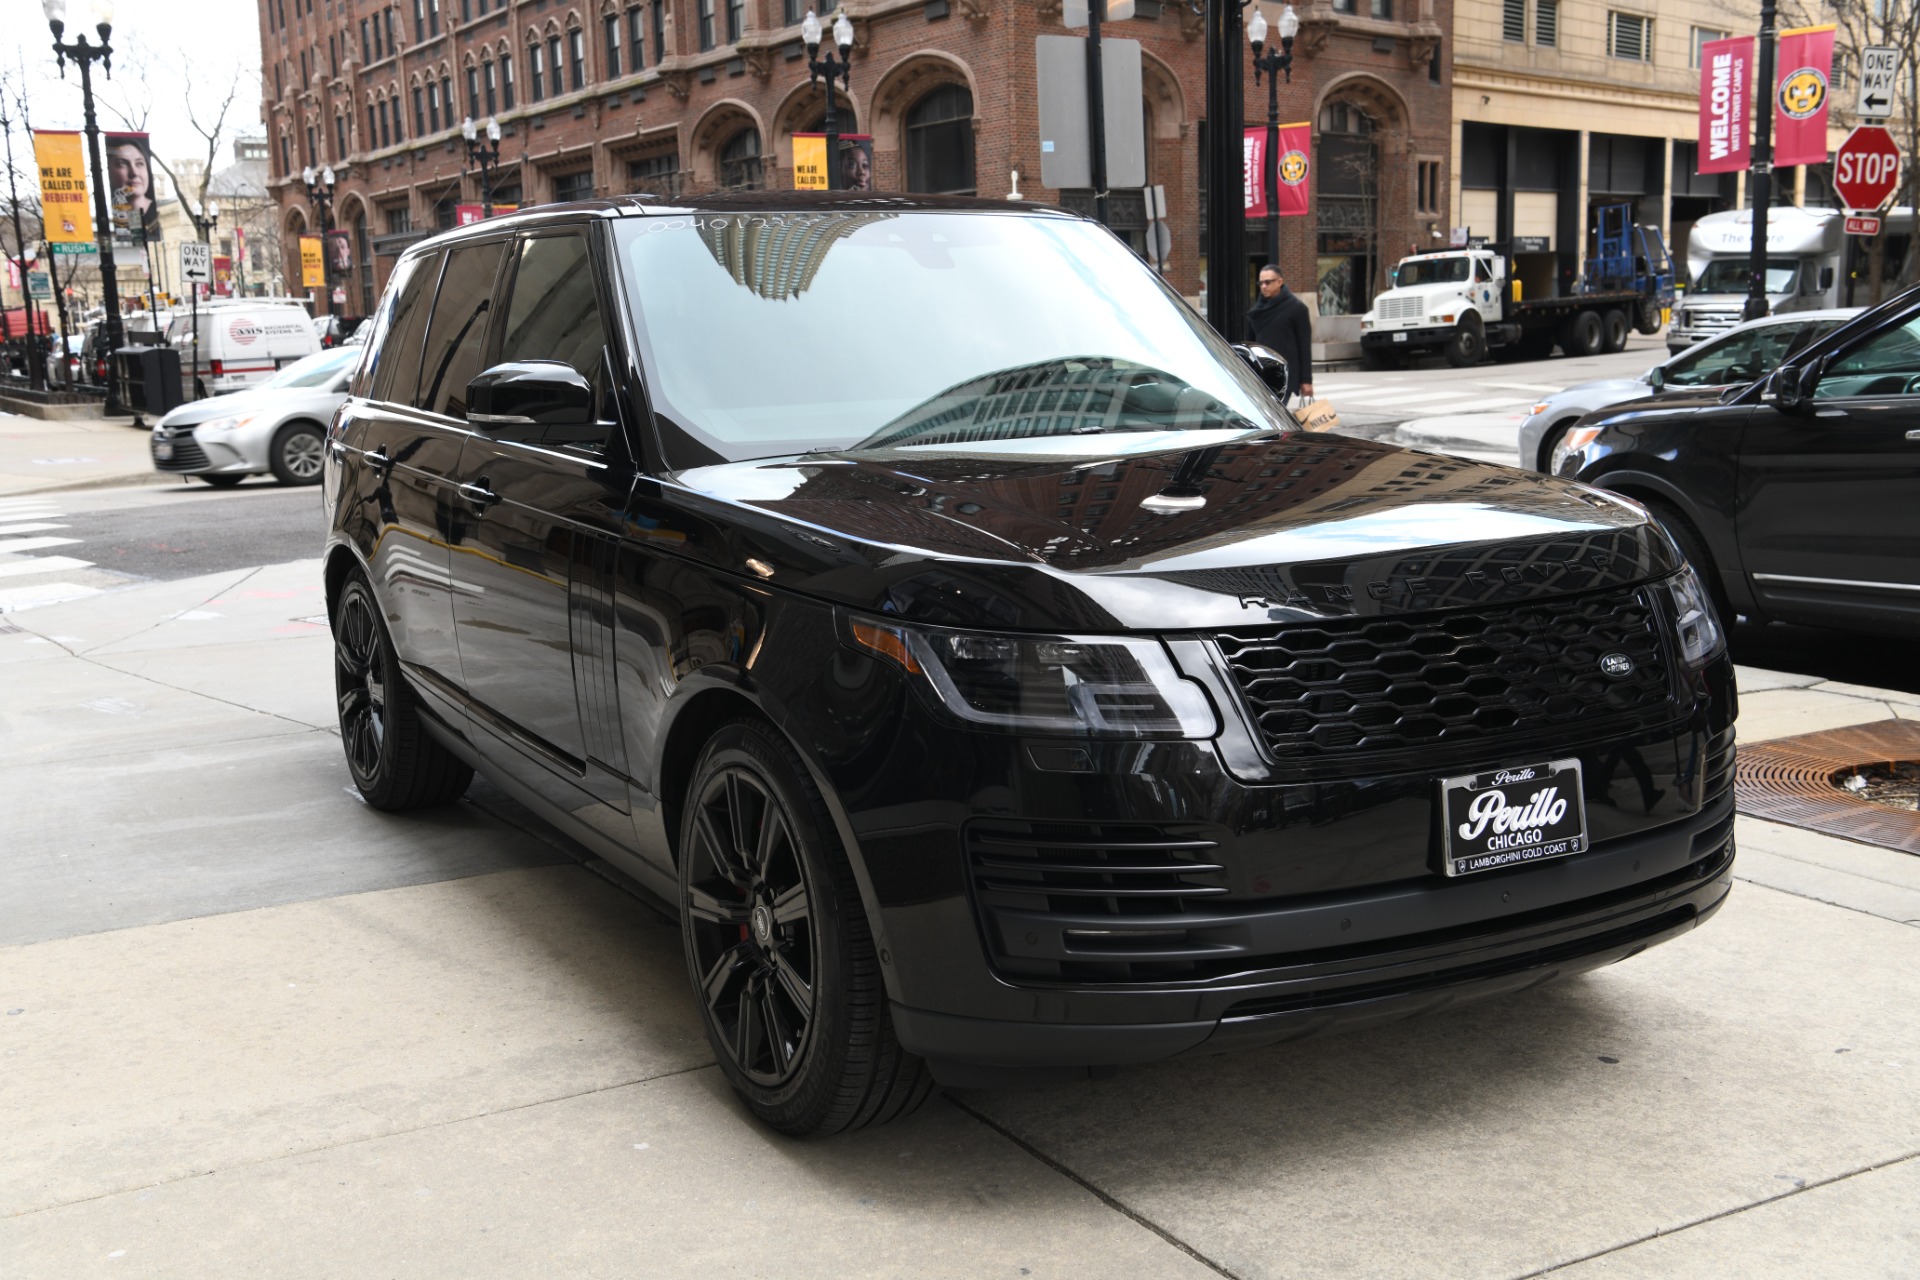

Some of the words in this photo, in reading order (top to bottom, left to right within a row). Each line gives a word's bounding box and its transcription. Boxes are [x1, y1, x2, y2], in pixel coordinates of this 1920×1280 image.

[1866, 54, 1894, 70] ONE
[1732, 58, 1743, 93] CAMPUS
[1864, 73, 1892, 89] WAY
[1709, 53, 1731, 160] WELCOME
[1732, 94, 1742, 123] TOWER
[1731, 124, 1741, 152] WATER
[41, 168, 54, 177] WE
[56, 168, 72, 177] ARE
[797, 165, 805, 174] WE
[807, 165, 817, 174] ARE
[1838, 152, 1897, 185] STOP
[42, 180, 72, 190] CALLED
[74, 181, 85, 190] TO
[797, 176, 816, 184] CALLED
[818, 176, 825, 184] TO
[44, 192, 84, 203] REDEFINE
[1848, 220, 1861, 230] ALL
[1862, 221, 1877, 232] WAY
[1721, 233, 1744, 243] The
[61, 243, 86, 254] RUSH
[183, 246, 206, 256] ONE
[183, 258, 206, 267] WAY
[1238, 577, 1430, 609] RANGE
[1464, 555, 1611, 588] ROVER
[1491, 768, 1536, 786] Perillo
[1458, 787, 1567, 841] Perillo
[1487, 829, 1542, 850] CHICAGO
[1469, 851, 1521, 869] LAMBORGHINI
[1522, 847, 1543, 859] GOLD
[1543, 842, 1568, 855] COAST
